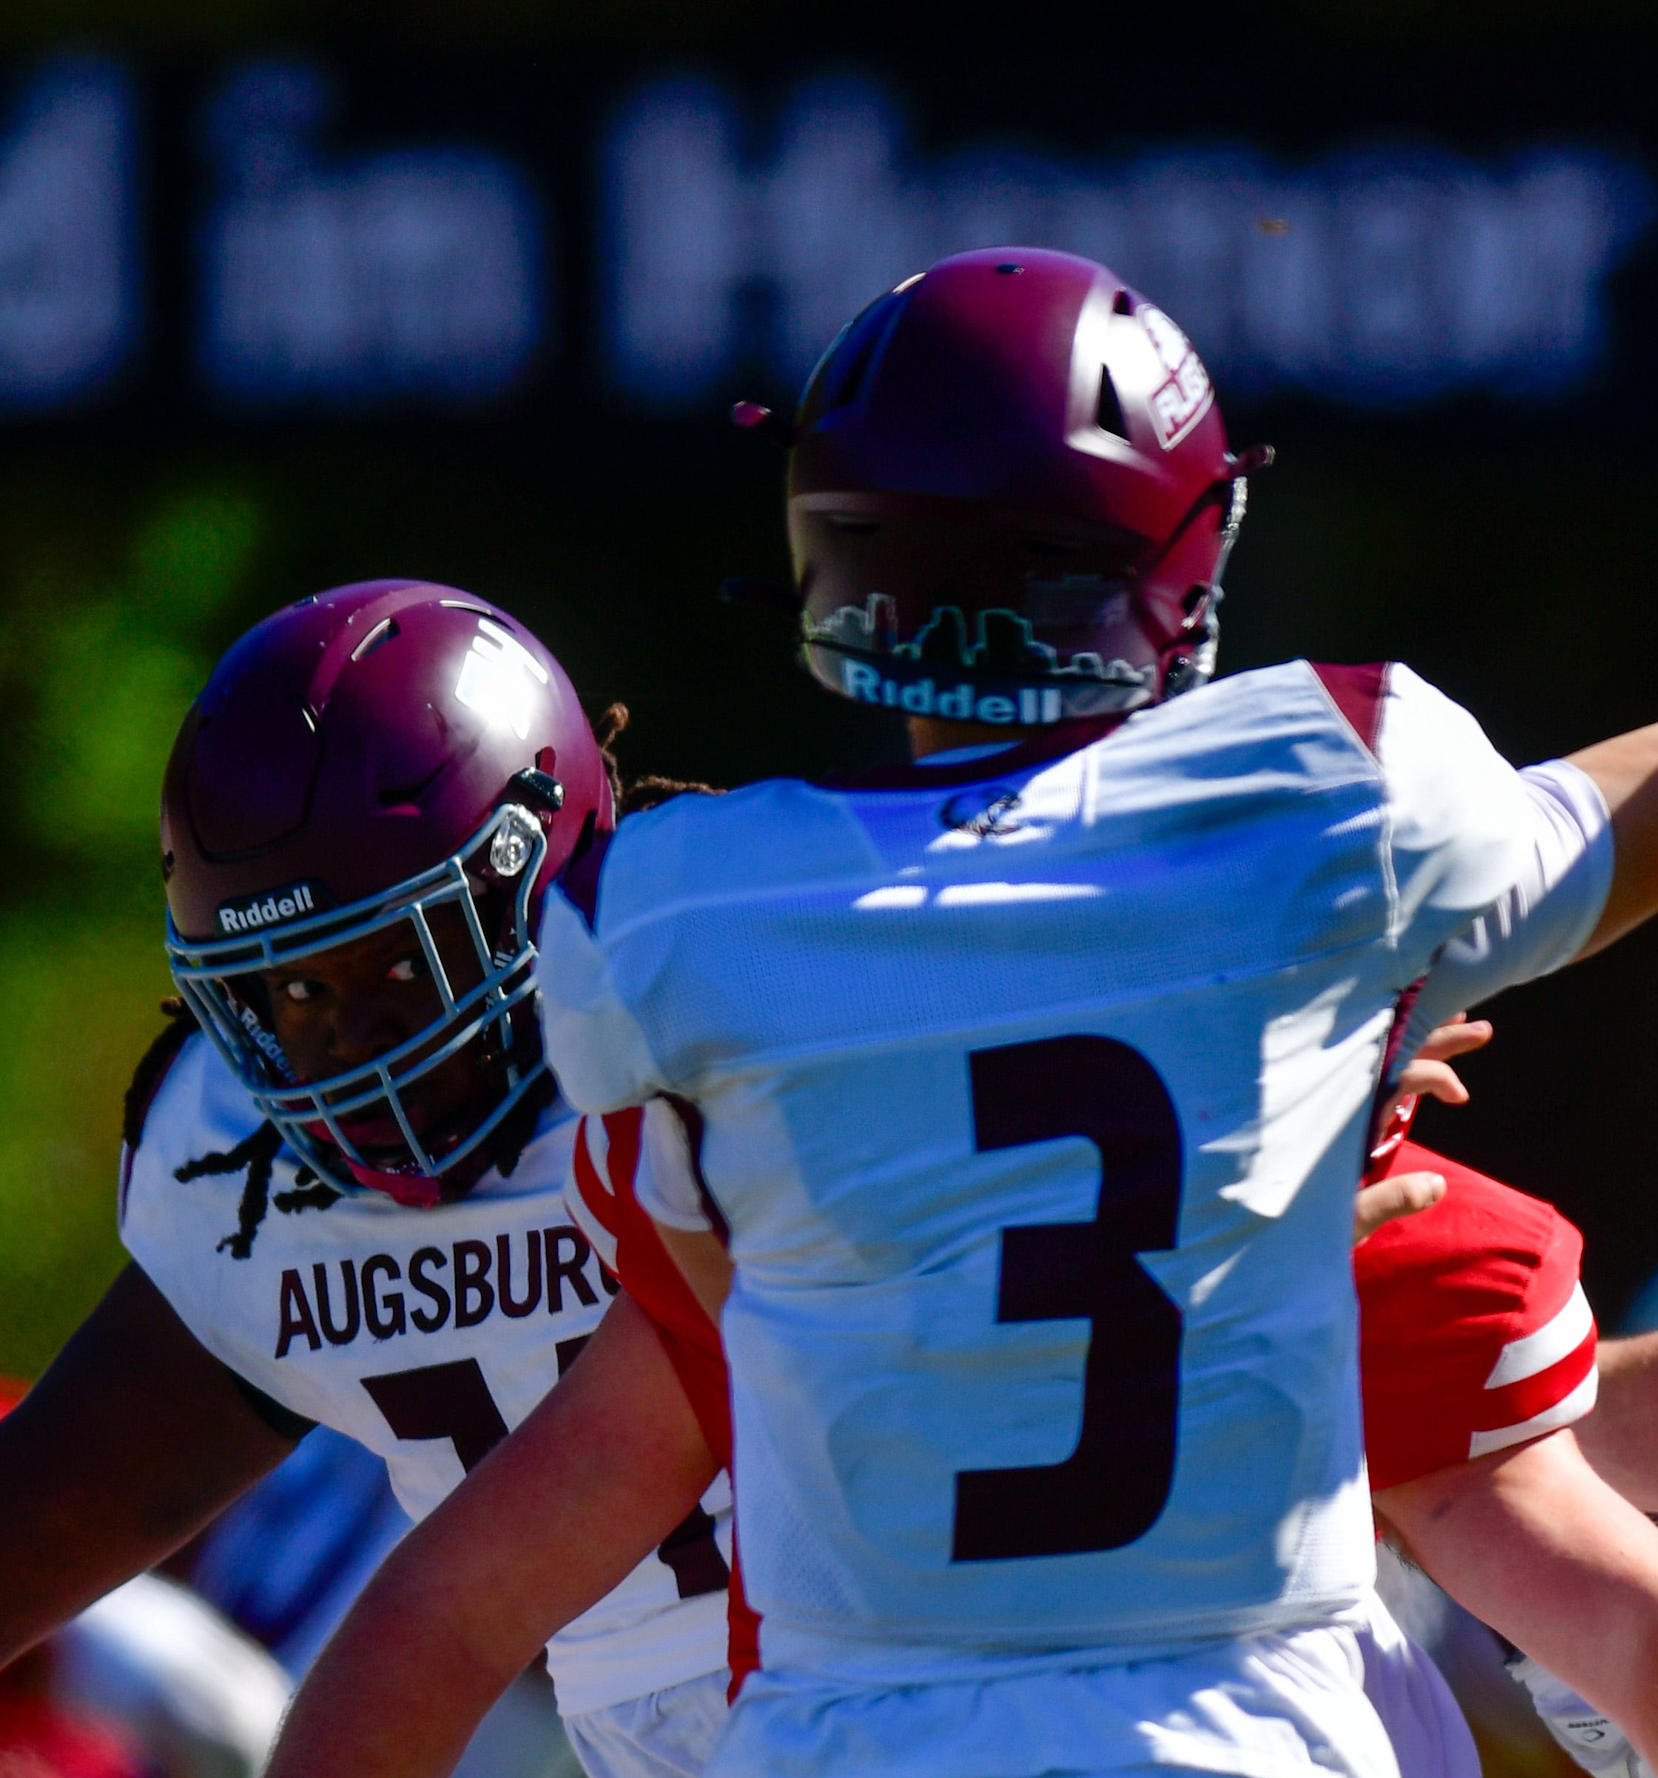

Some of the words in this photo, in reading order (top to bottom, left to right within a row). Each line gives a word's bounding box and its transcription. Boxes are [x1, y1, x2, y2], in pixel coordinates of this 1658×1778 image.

[842, 657, 1064, 727] Riddell
[218, 885, 315, 932] Riddell
[950, 1033, 1185, 1564] 3
